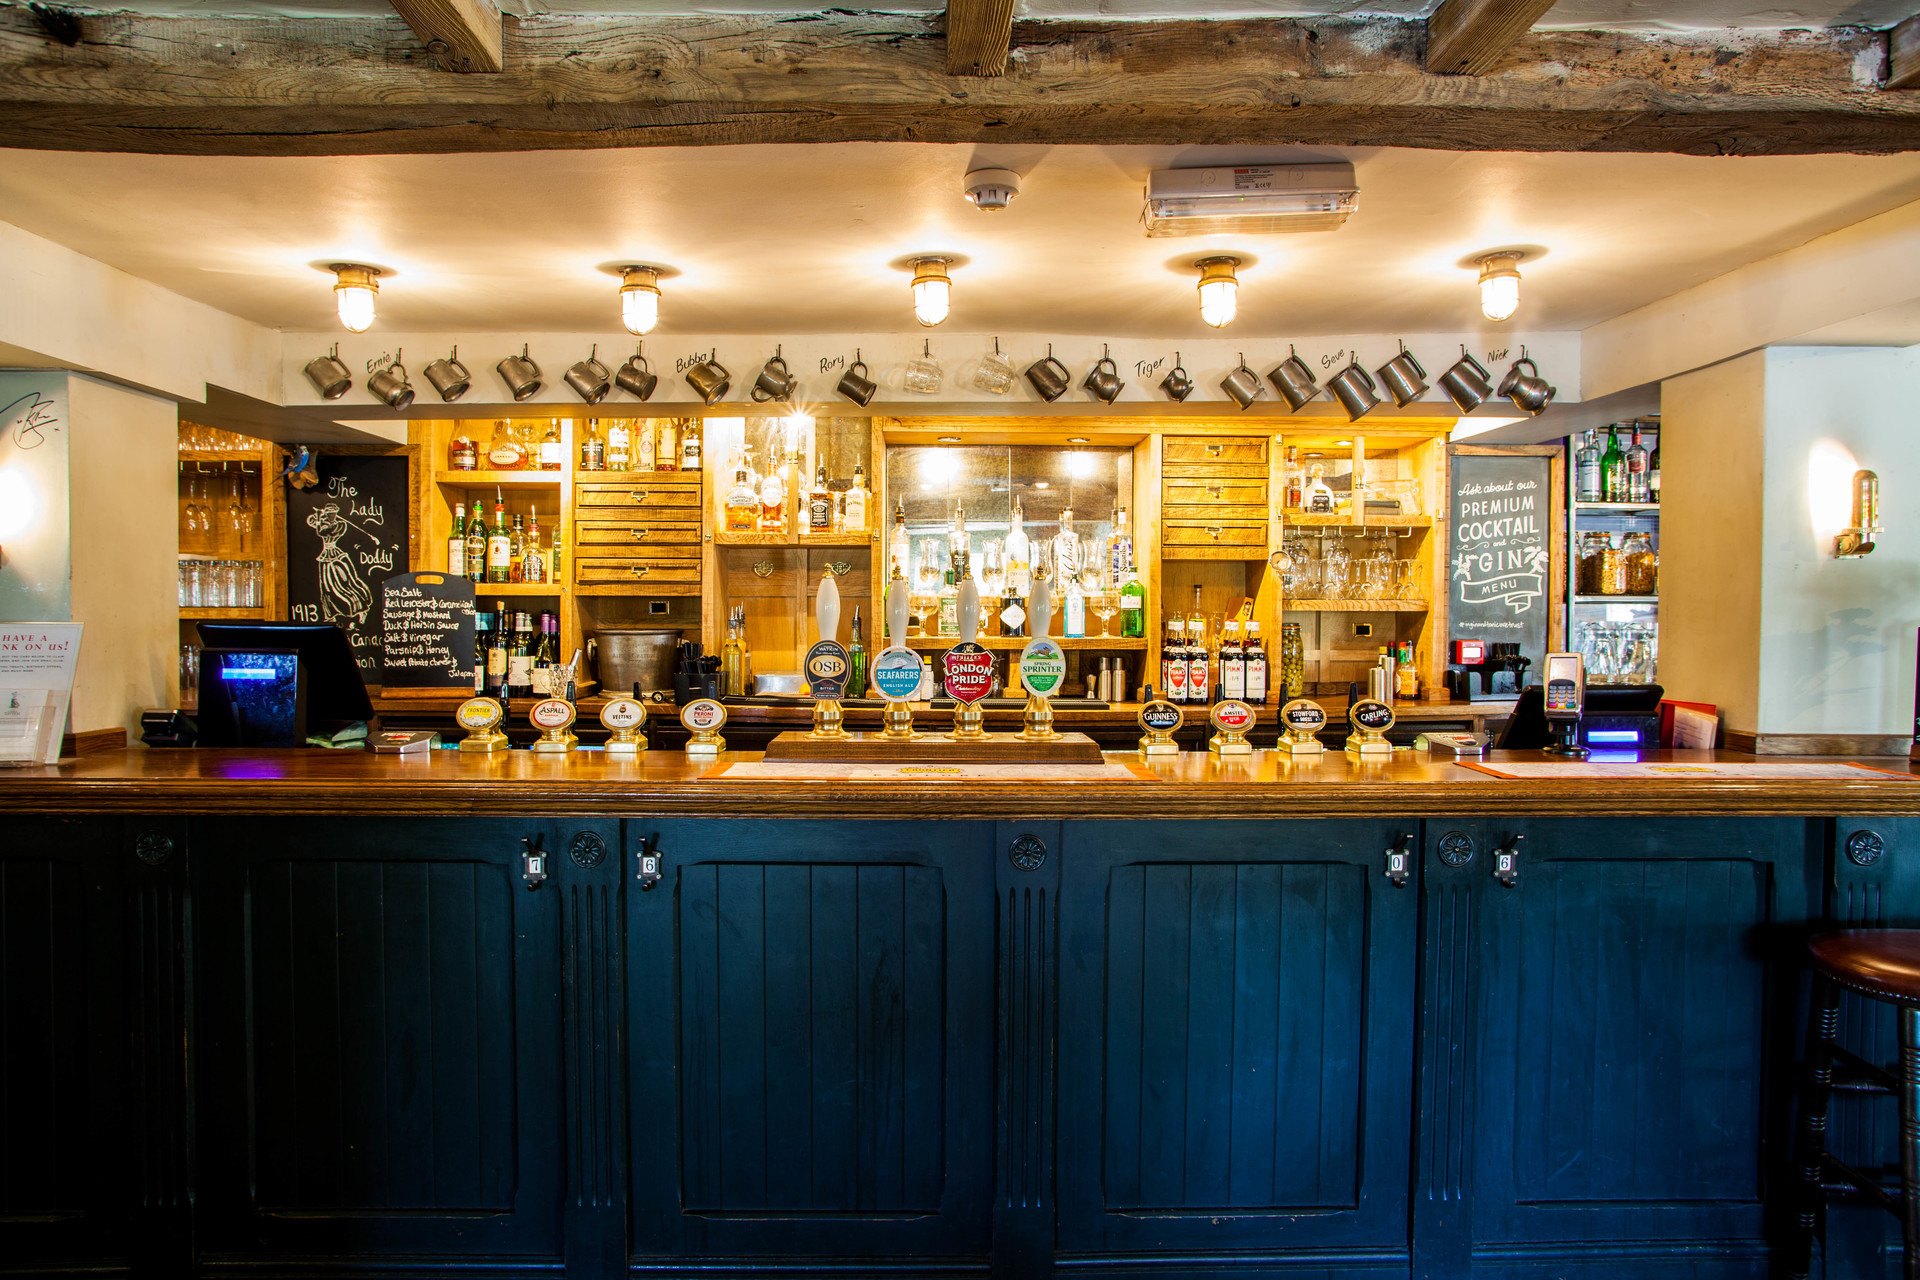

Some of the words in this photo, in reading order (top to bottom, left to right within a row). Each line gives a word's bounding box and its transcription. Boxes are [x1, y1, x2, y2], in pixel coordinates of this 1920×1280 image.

[676, 352, 707, 373] Bubba
[1321, 348, 1345, 369] Seve
[1487, 348, 1510, 364] Nick
[366, 352, 391, 374] Ernie
[820, 355, 844, 374] Rory
[1134, 356, 1165, 378] Tiger
[327, 476, 358, 498] The
[1458, 484, 1482, 496] Ask
[1484, 480, 1514, 493] about
[1517, 480, 1537, 490] our
[350, 497, 384, 525] Lady
[1462, 496, 1534, 518] PREMIUM
[1458, 515, 1539, 542] COCKTAIL
[1479, 549, 1523, 572] GIN
[384, 587, 400, 597] Sea
[401, 587, 422, 597] Salt
[1482, 579, 1517, 595] MENU
[385, 598, 400, 608] Red
[292, 604, 318, 622] 1913
[383, 608, 414, 620] Sausage
[423, 611, 451, 619] Mustard
[383, 621, 402, 630] Duck
[411, 620, 435, 629] Hoisin
[437, 622, 459, 630] Sauce
[384, 632, 401, 642] Salt
[410, 634, 444, 645] Vinegar
[385, 645, 417, 655] Parsnip
[426, 647, 450, 660] Honey
[384, 658, 407, 667] Sweet
[813, 661, 841, 672] OSB
[878, 671, 919, 679] SEAFARERS
[944, 664, 994, 676] LONDON
[953, 676, 985, 684] PRIDE
[539, 706, 565, 716] ASPALL
[1144, 712, 1178, 720] GUINNESS
[1361, 709, 1388, 721] CARLING
[531, 859, 539, 871] 7
[645, 859, 654, 871] 6
[1501, 857, 1509, 869] 6
